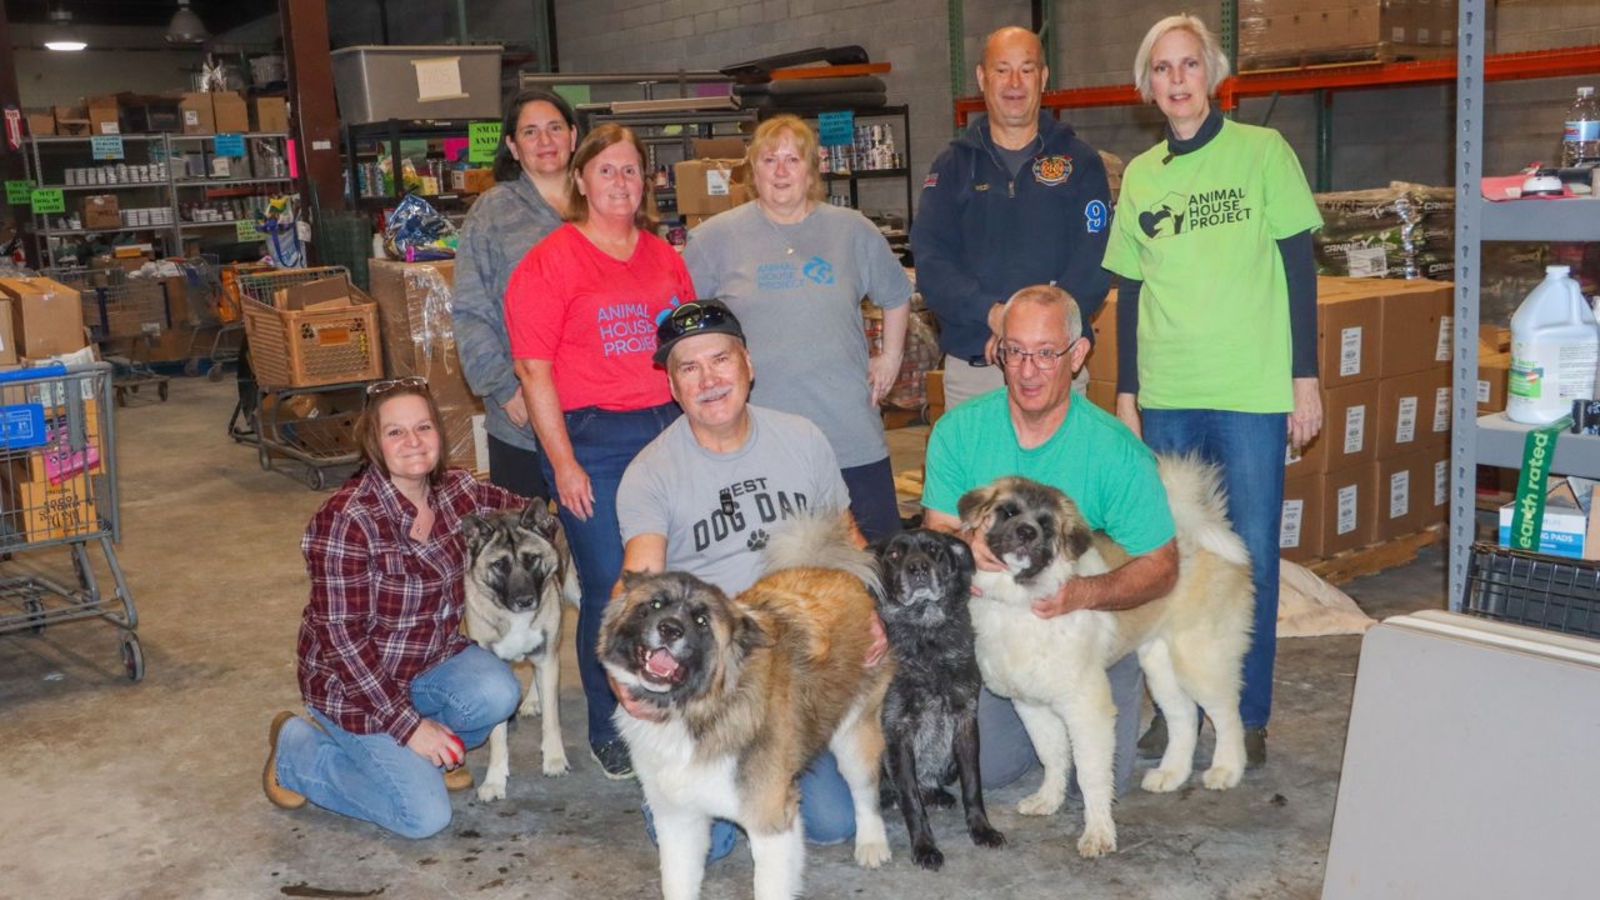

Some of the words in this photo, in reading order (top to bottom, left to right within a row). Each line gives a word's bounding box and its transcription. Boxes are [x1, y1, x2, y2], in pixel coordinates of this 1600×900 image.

[1188, 187, 1247, 206] ANIMAL
[1085, 200, 1107, 233] 9
[1189, 199, 1240, 218] HOUSE
[1190, 207, 1252, 230] PROJECT
[757, 263, 798, 272] ANIMAL
[758, 272, 795, 281] HOUSE
[758, 280, 804, 290] PROJECT
[597, 303, 650, 322] ANIMAL
[1528, 432, 1549, 490] rated
[693, 500, 746, 552] DOG
[1520, 493, 1539, 549] earth
[1550, 533, 1574, 544] PADS
